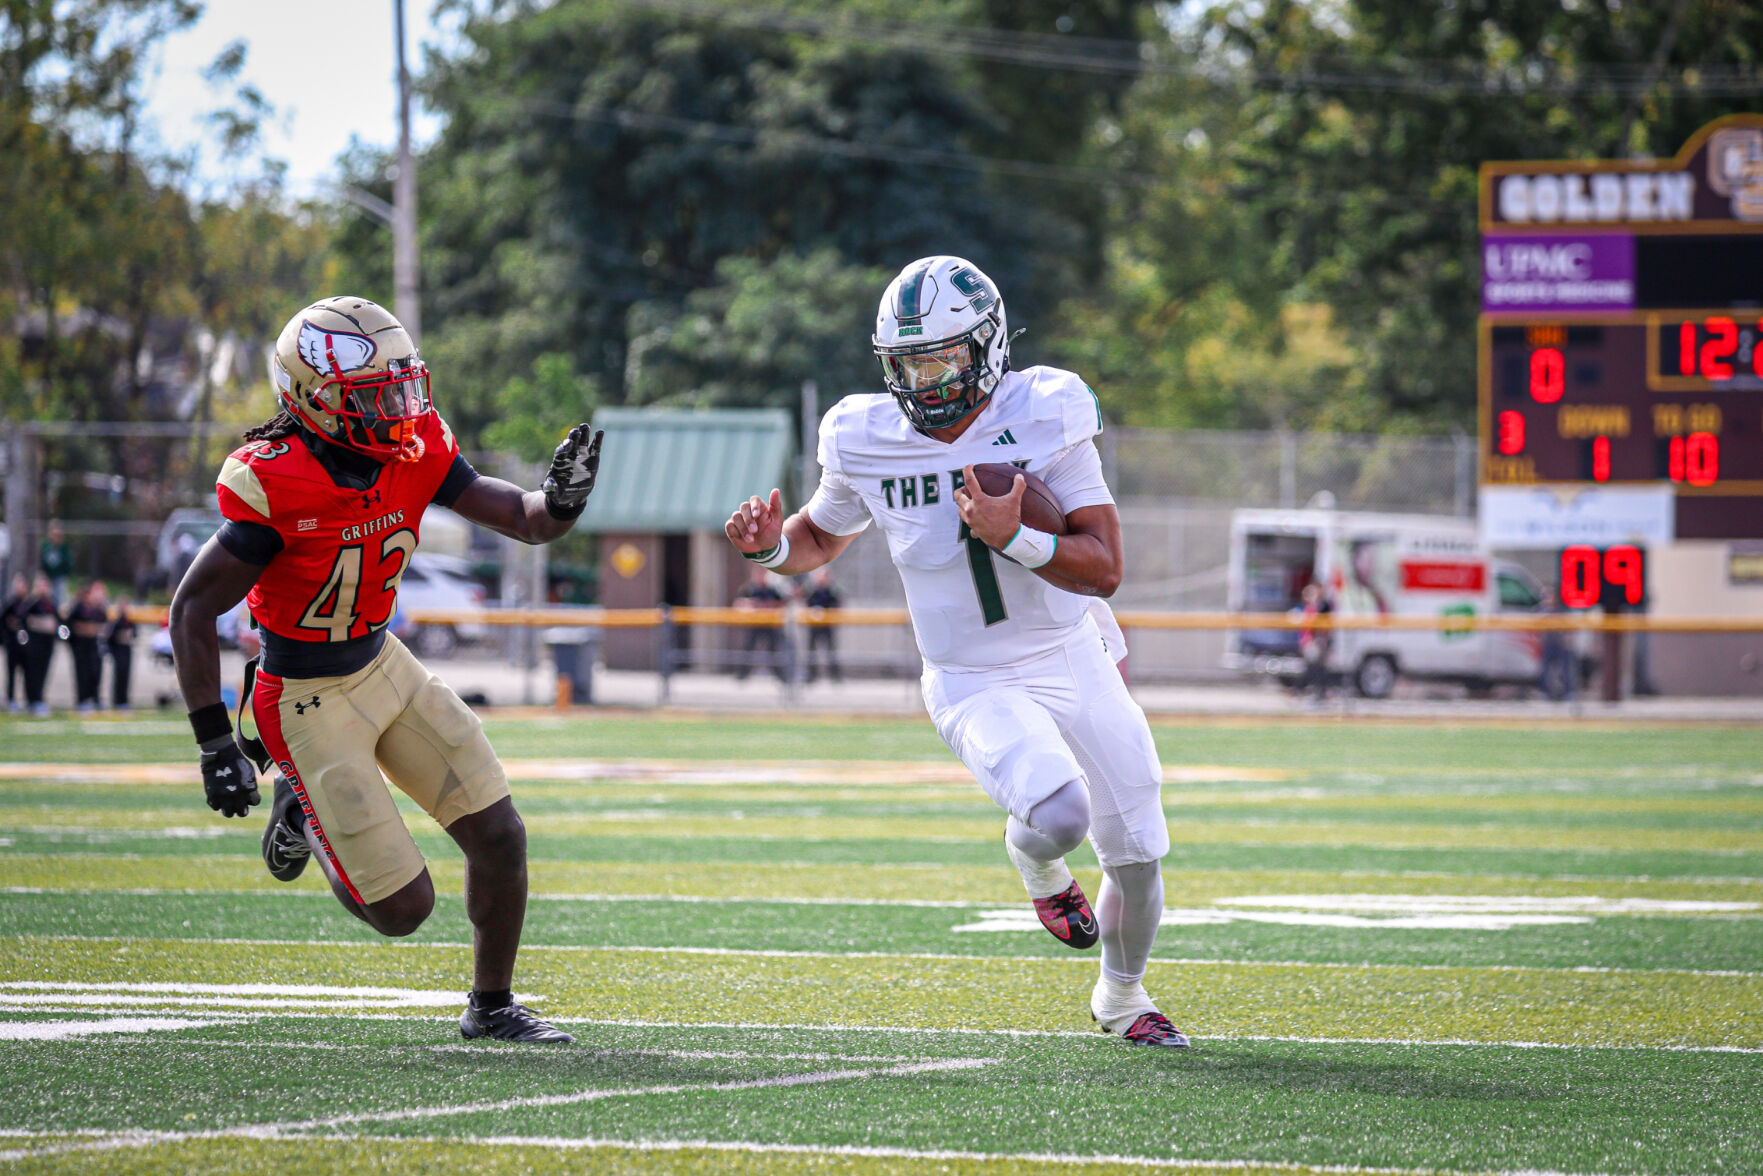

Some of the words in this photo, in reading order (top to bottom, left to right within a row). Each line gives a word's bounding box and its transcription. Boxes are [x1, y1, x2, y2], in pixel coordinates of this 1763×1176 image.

[1501, 174, 1694, 221] GOLDEN
[1486, 244, 1592, 278] UPMC
[898, 326, 923, 337] ROCK
[1529, 348, 1565, 403] 0
[1593, 435, 1610, 482] 1
[1669, 432, 1719, 486] 10
[881, 473, 940, 509] THE
[341, 509, 404, 541] GRIFFINS
[295, 527, 419, 642] 43
[1561, 544, 1643, 608] 09
